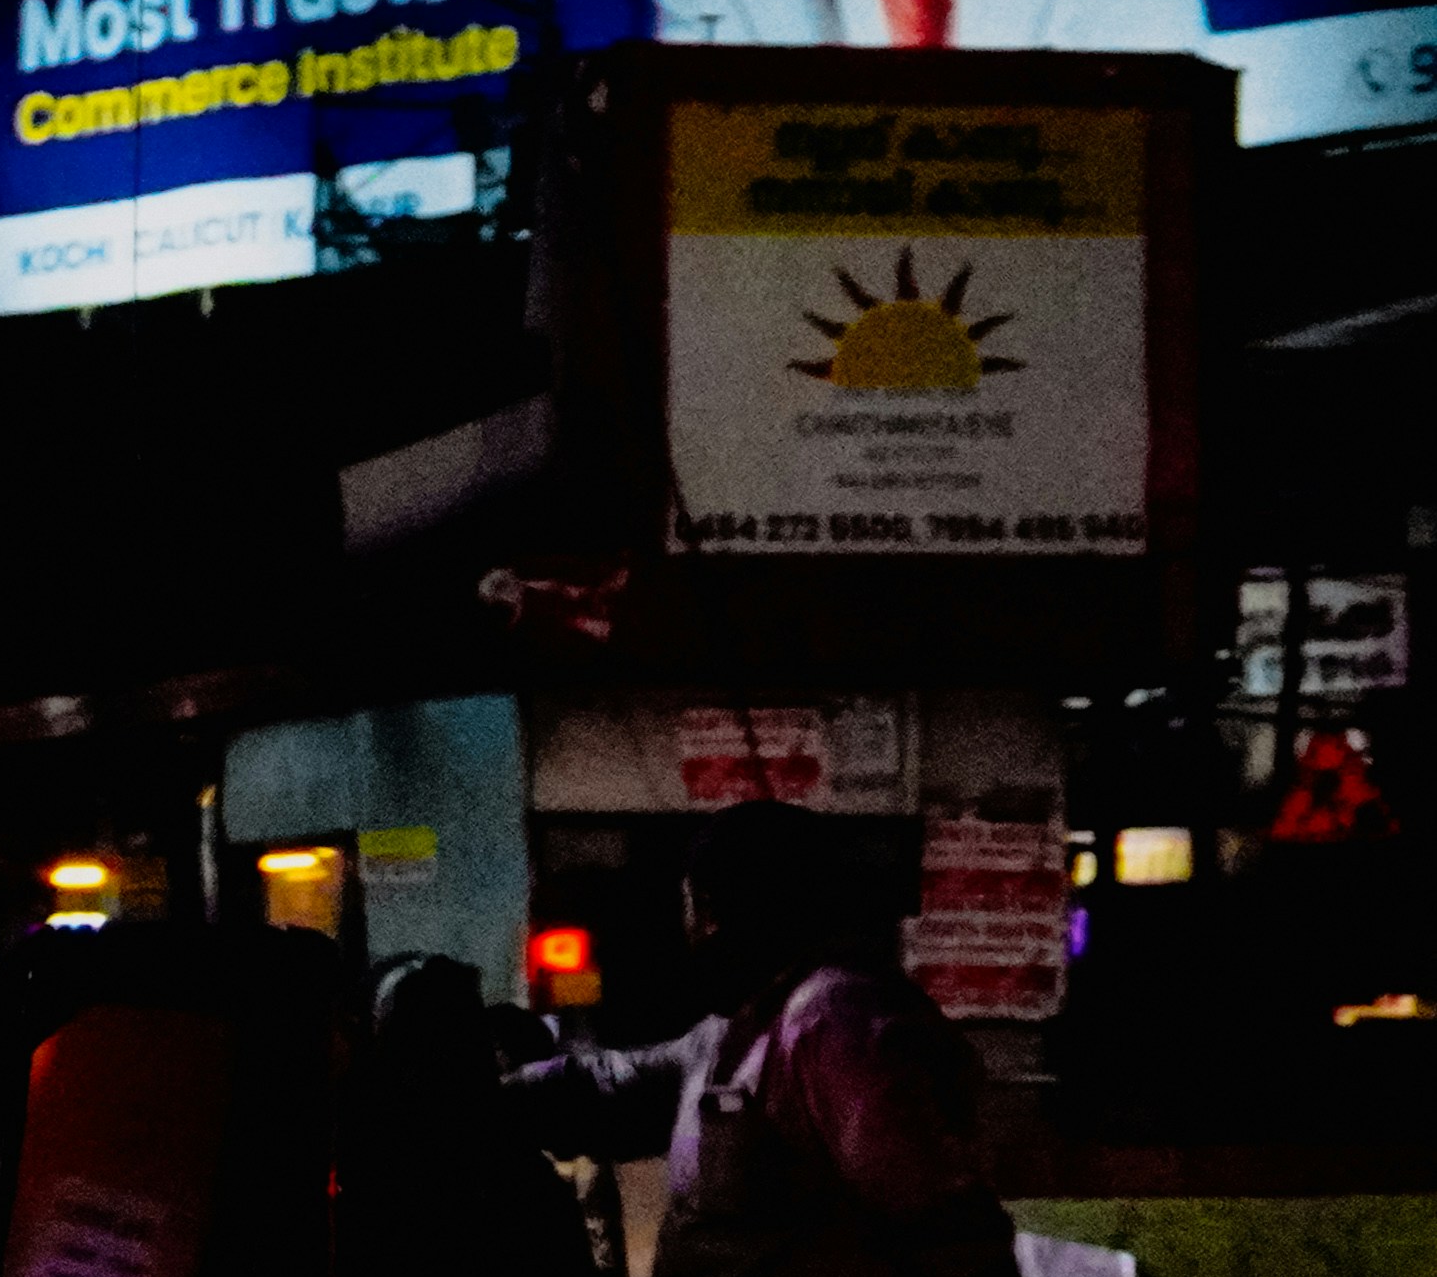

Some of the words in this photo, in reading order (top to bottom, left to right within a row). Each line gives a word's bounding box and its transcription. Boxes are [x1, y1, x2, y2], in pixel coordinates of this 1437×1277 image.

[14, 60, 290, 145] Commerce
[296, 24, 520, 98] Institute
[135, 210, 262, 259] CALICUT
